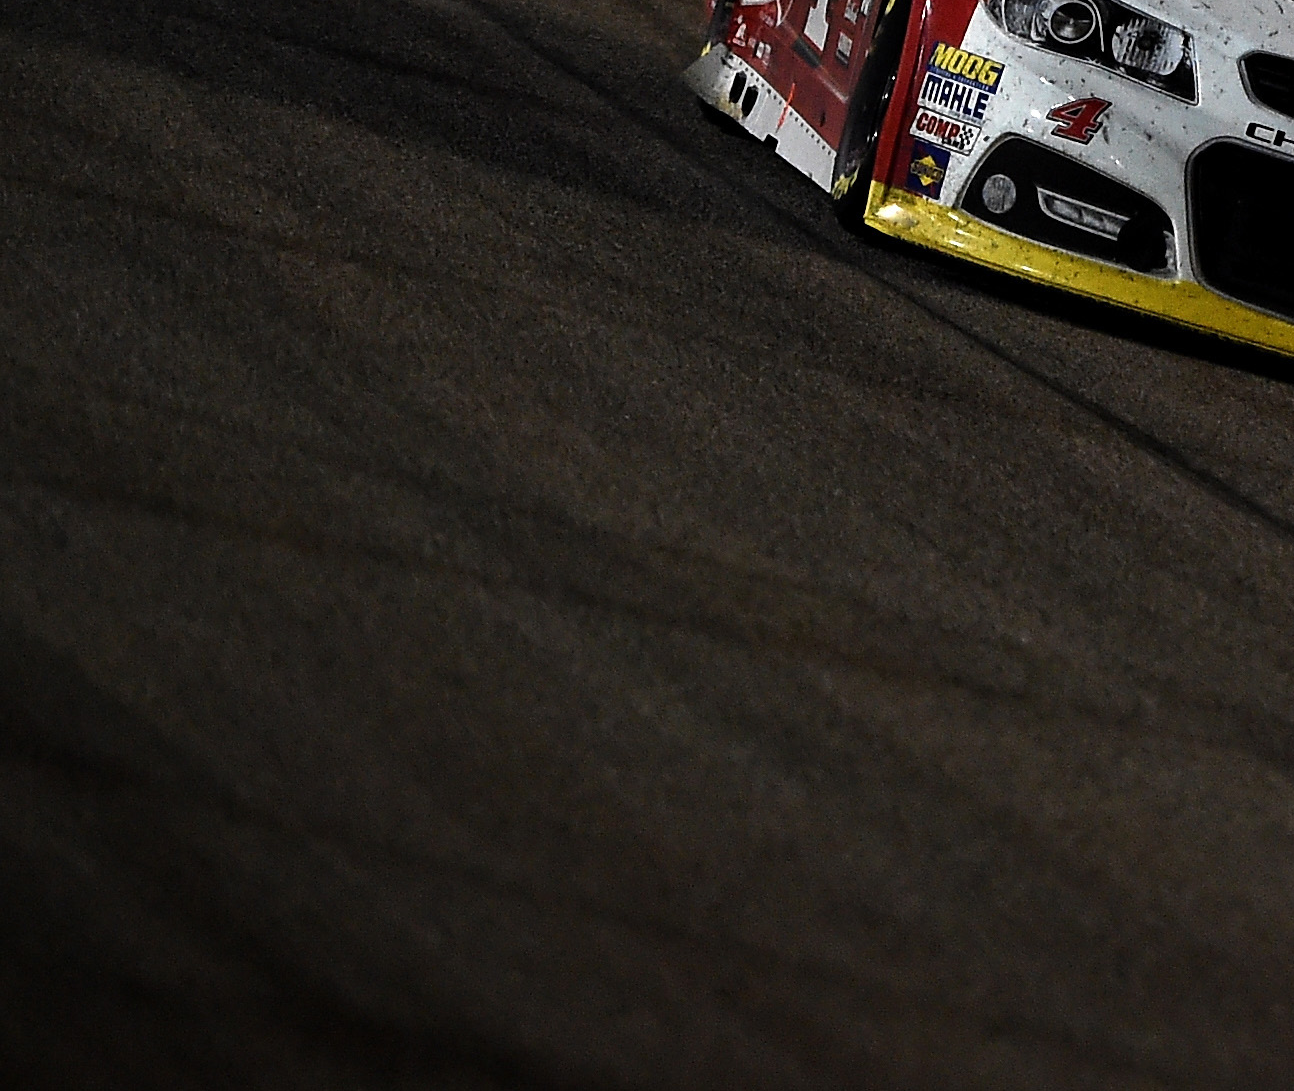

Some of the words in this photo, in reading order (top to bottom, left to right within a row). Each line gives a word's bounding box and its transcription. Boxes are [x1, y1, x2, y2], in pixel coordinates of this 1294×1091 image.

[929, 42, 1002, 87] MOOG
[921, 74, 990, 120] MAHLE
[915, 111, 962, 140] COMP
[1046, 97, 1113, 146] 4
